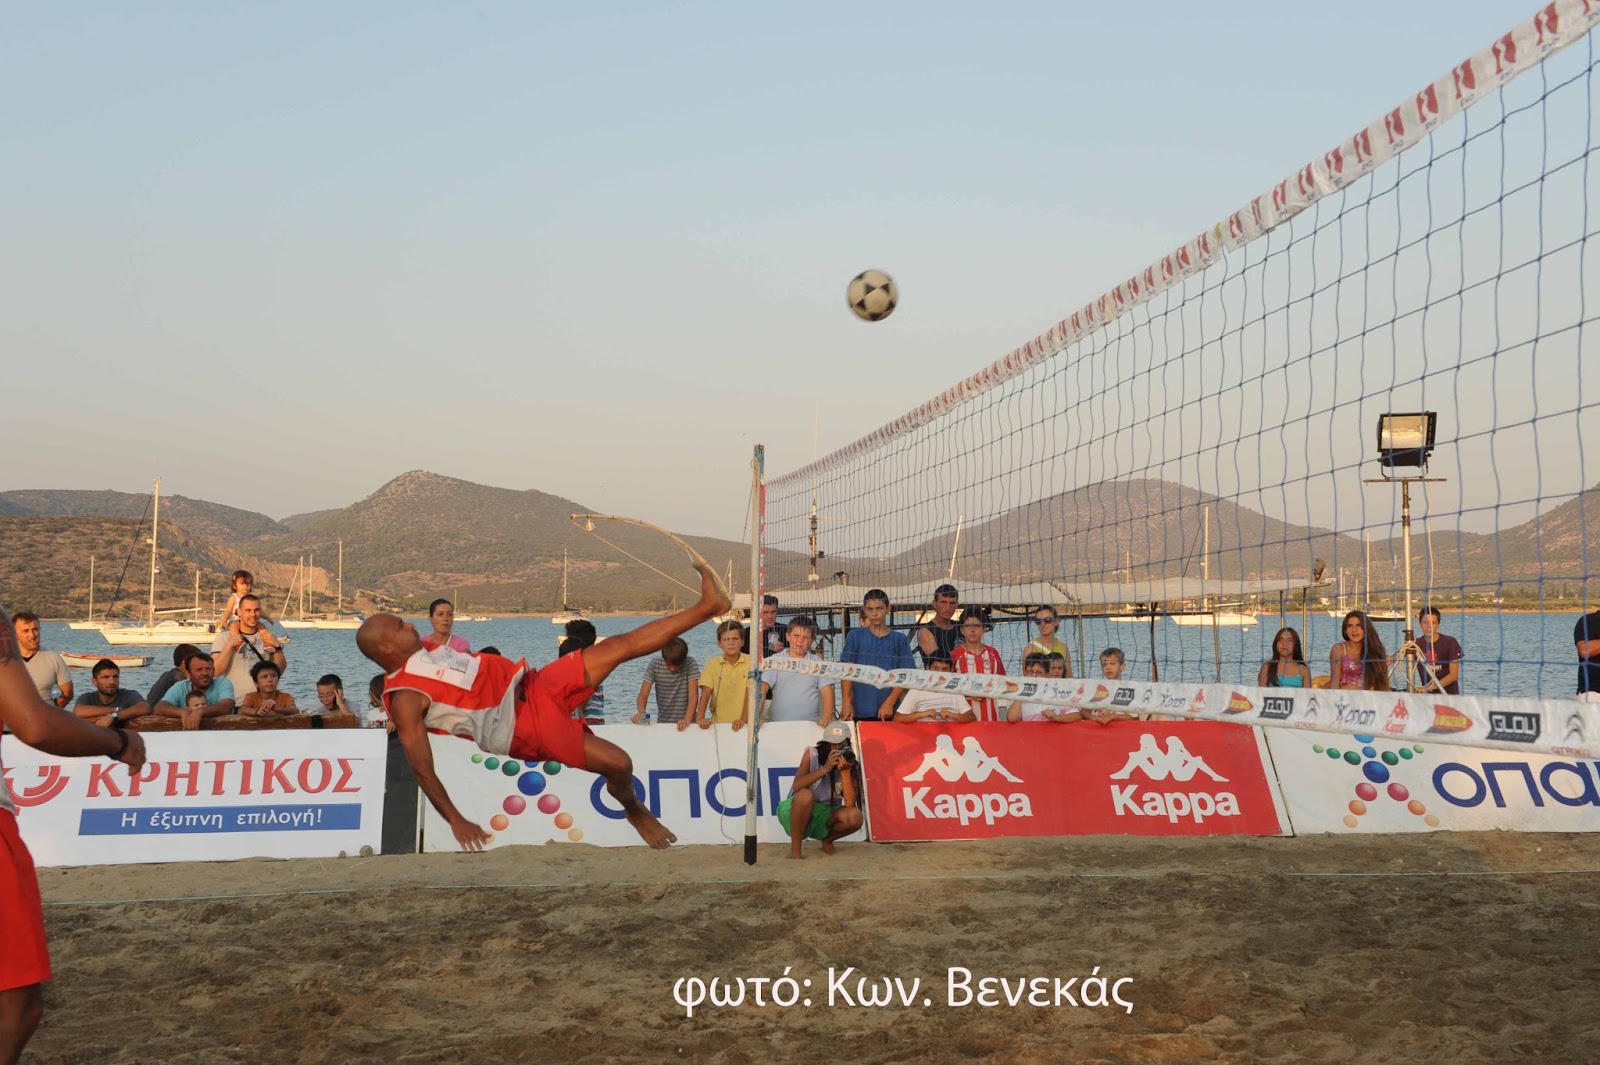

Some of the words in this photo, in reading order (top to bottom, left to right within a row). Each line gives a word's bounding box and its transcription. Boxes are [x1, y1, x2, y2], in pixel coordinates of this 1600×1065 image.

[86, 758, 364, 798] ΚΡΗΤΙΚΟΣ
[1431, 761, 1600, 808] οπα
[121, 812, 138, 828] Η
[149, 811, 223, 830] έξυπνη
[236, 808, 322, 827] επιλογή!
[902, 786, 1034, 826] Kappa
[1109, 784, 1242, 824] Kappa
